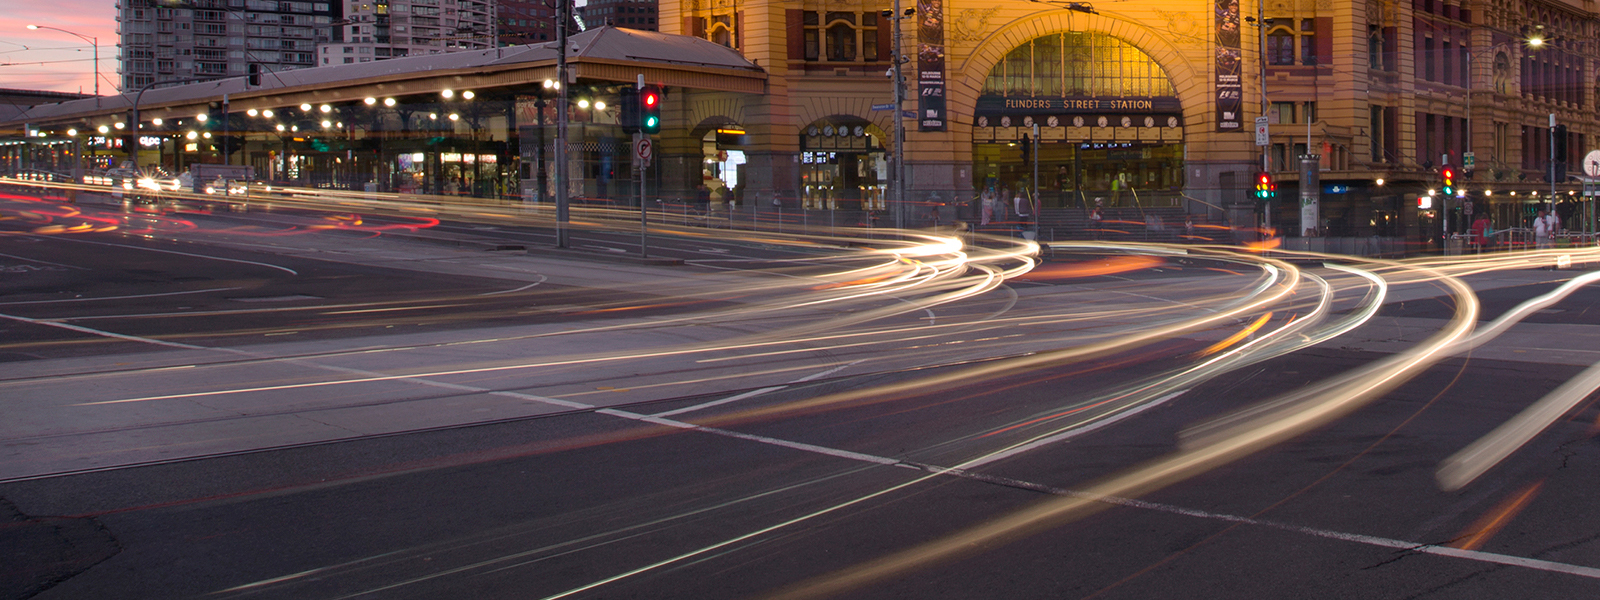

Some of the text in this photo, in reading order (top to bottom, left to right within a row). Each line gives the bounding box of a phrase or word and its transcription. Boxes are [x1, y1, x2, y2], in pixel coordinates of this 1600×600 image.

[1005, 99, 1152, 109] FLINDERS STREET STATION
